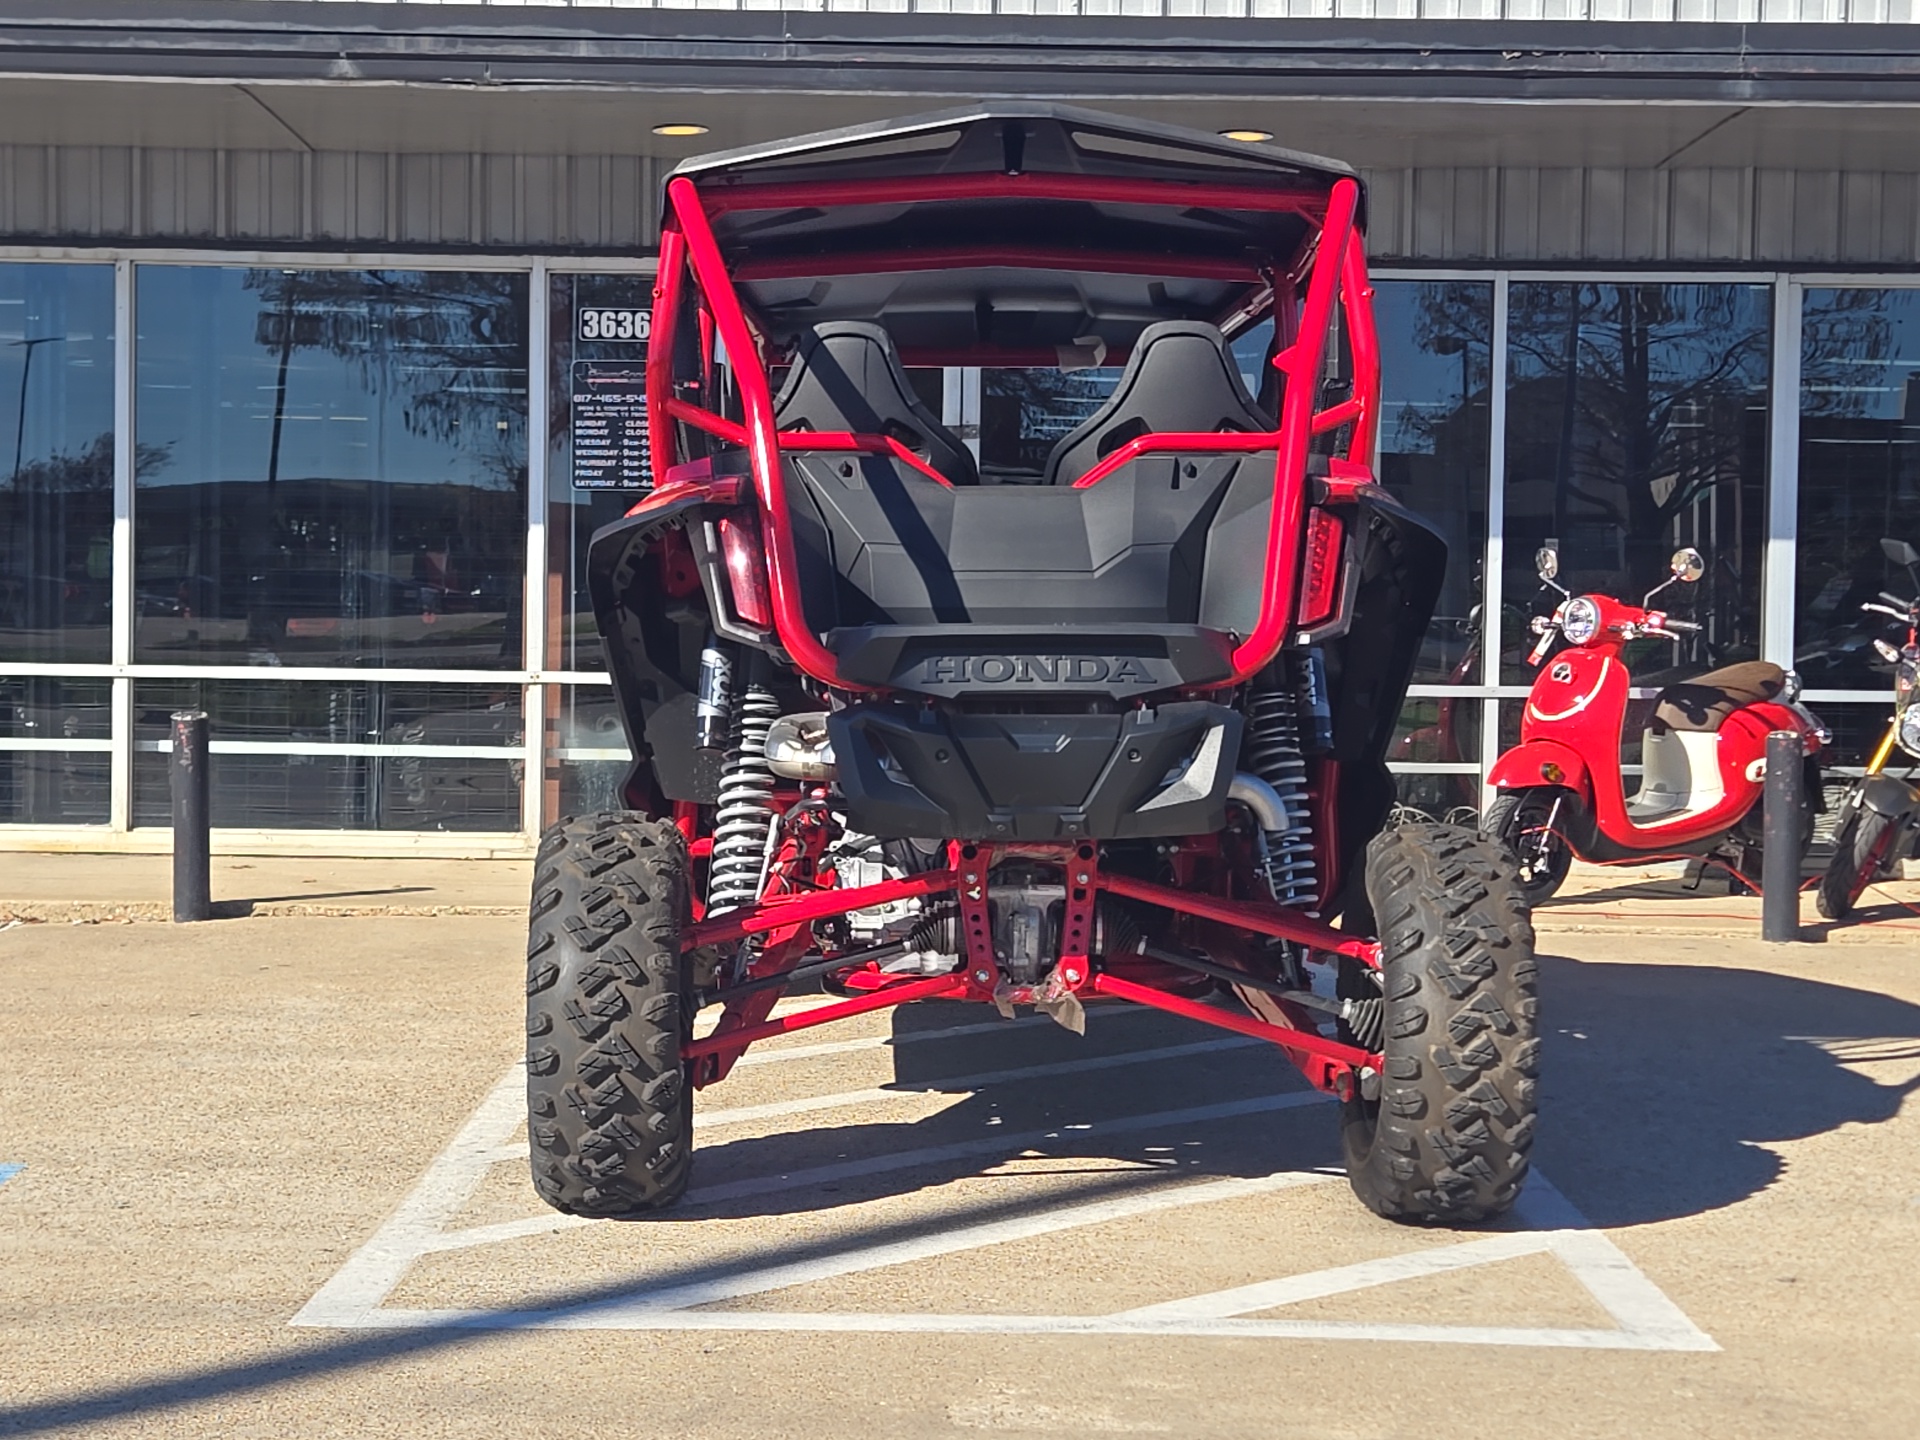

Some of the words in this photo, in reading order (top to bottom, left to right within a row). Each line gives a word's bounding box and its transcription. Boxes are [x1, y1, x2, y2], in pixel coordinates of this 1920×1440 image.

[583, 311, 650, 339] 3636
[712, 656, 732, 706] FOX
[921, 655, 1157, 684] HONDA
